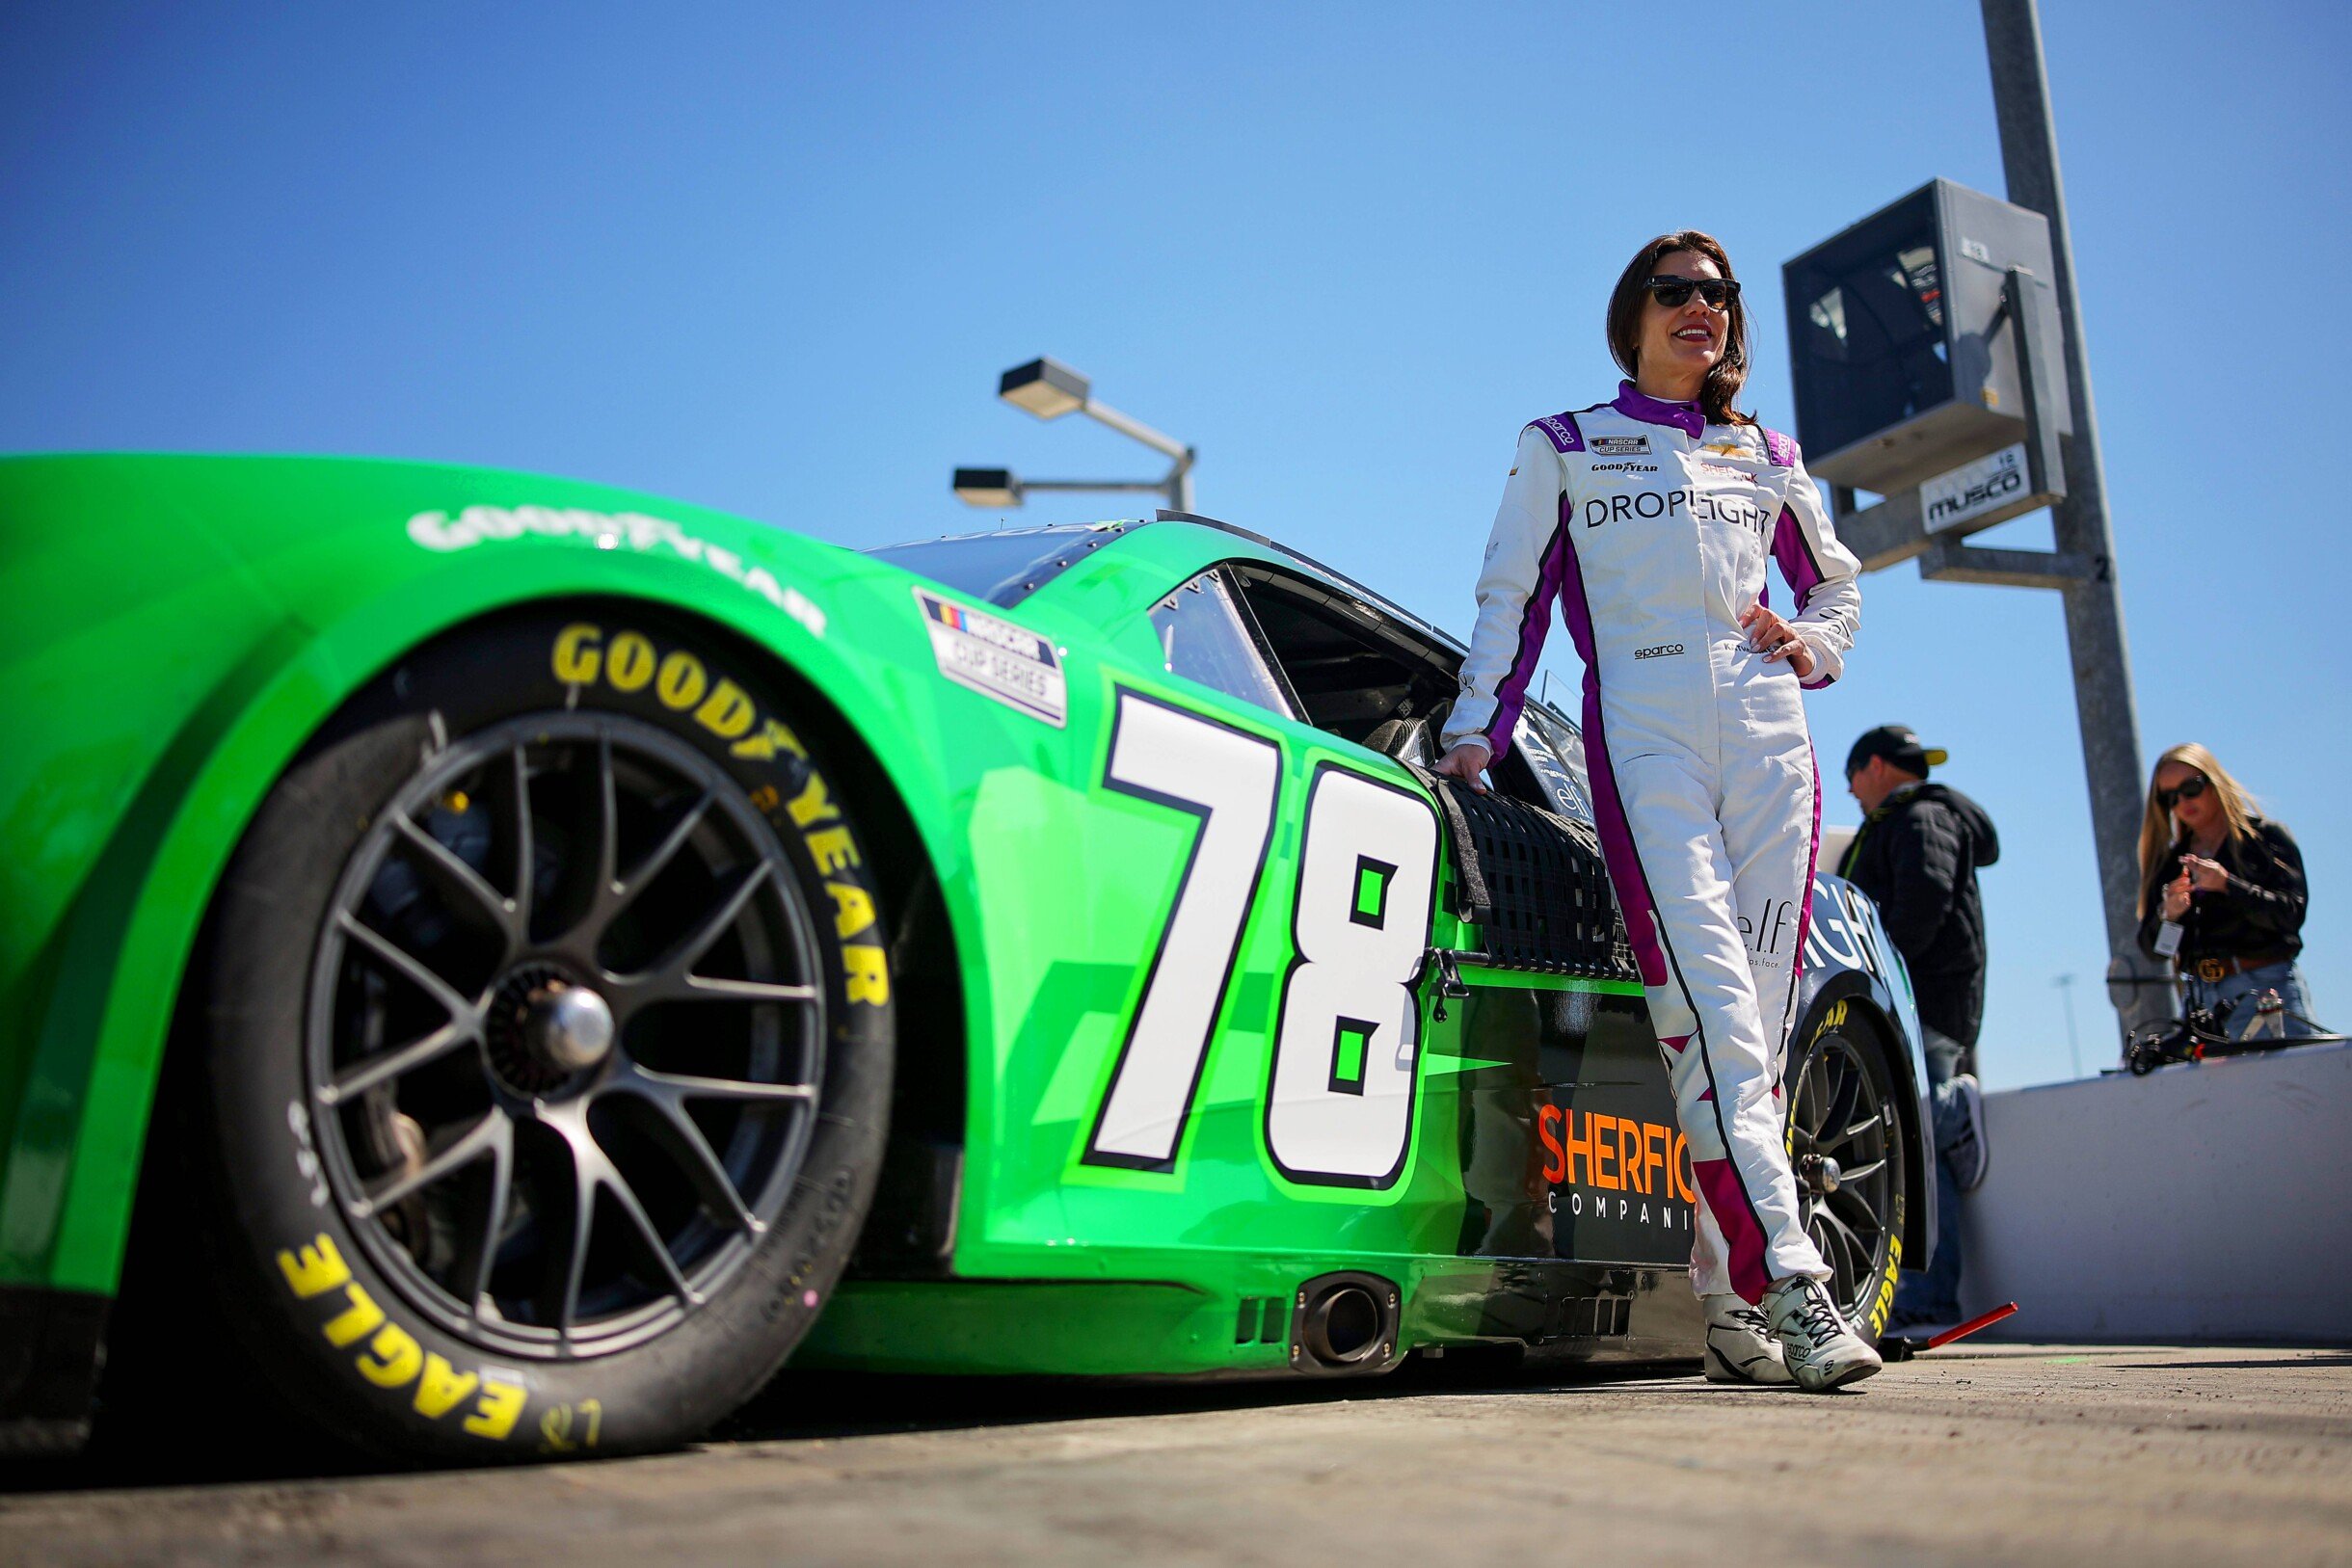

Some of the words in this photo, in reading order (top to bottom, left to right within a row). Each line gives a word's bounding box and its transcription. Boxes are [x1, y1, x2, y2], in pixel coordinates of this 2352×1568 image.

[1591, 462, 1658, 472] GOODYEAR
[1586, 490, 1772, 537] DROPLIGHT
[992, 652, 1049, 698] SERIES
[1634, 643, 1684, 660] sparco
[1081, 682, 1441, 1190] 78
[1538, 1103, 1697, 1204] SHERFIC
[1548, 1191, 1688, 1231] COMPANI
[1868, 1233, 1903, 1340] EAGLE
[277, 1232, 529, 1442] EAGLE
